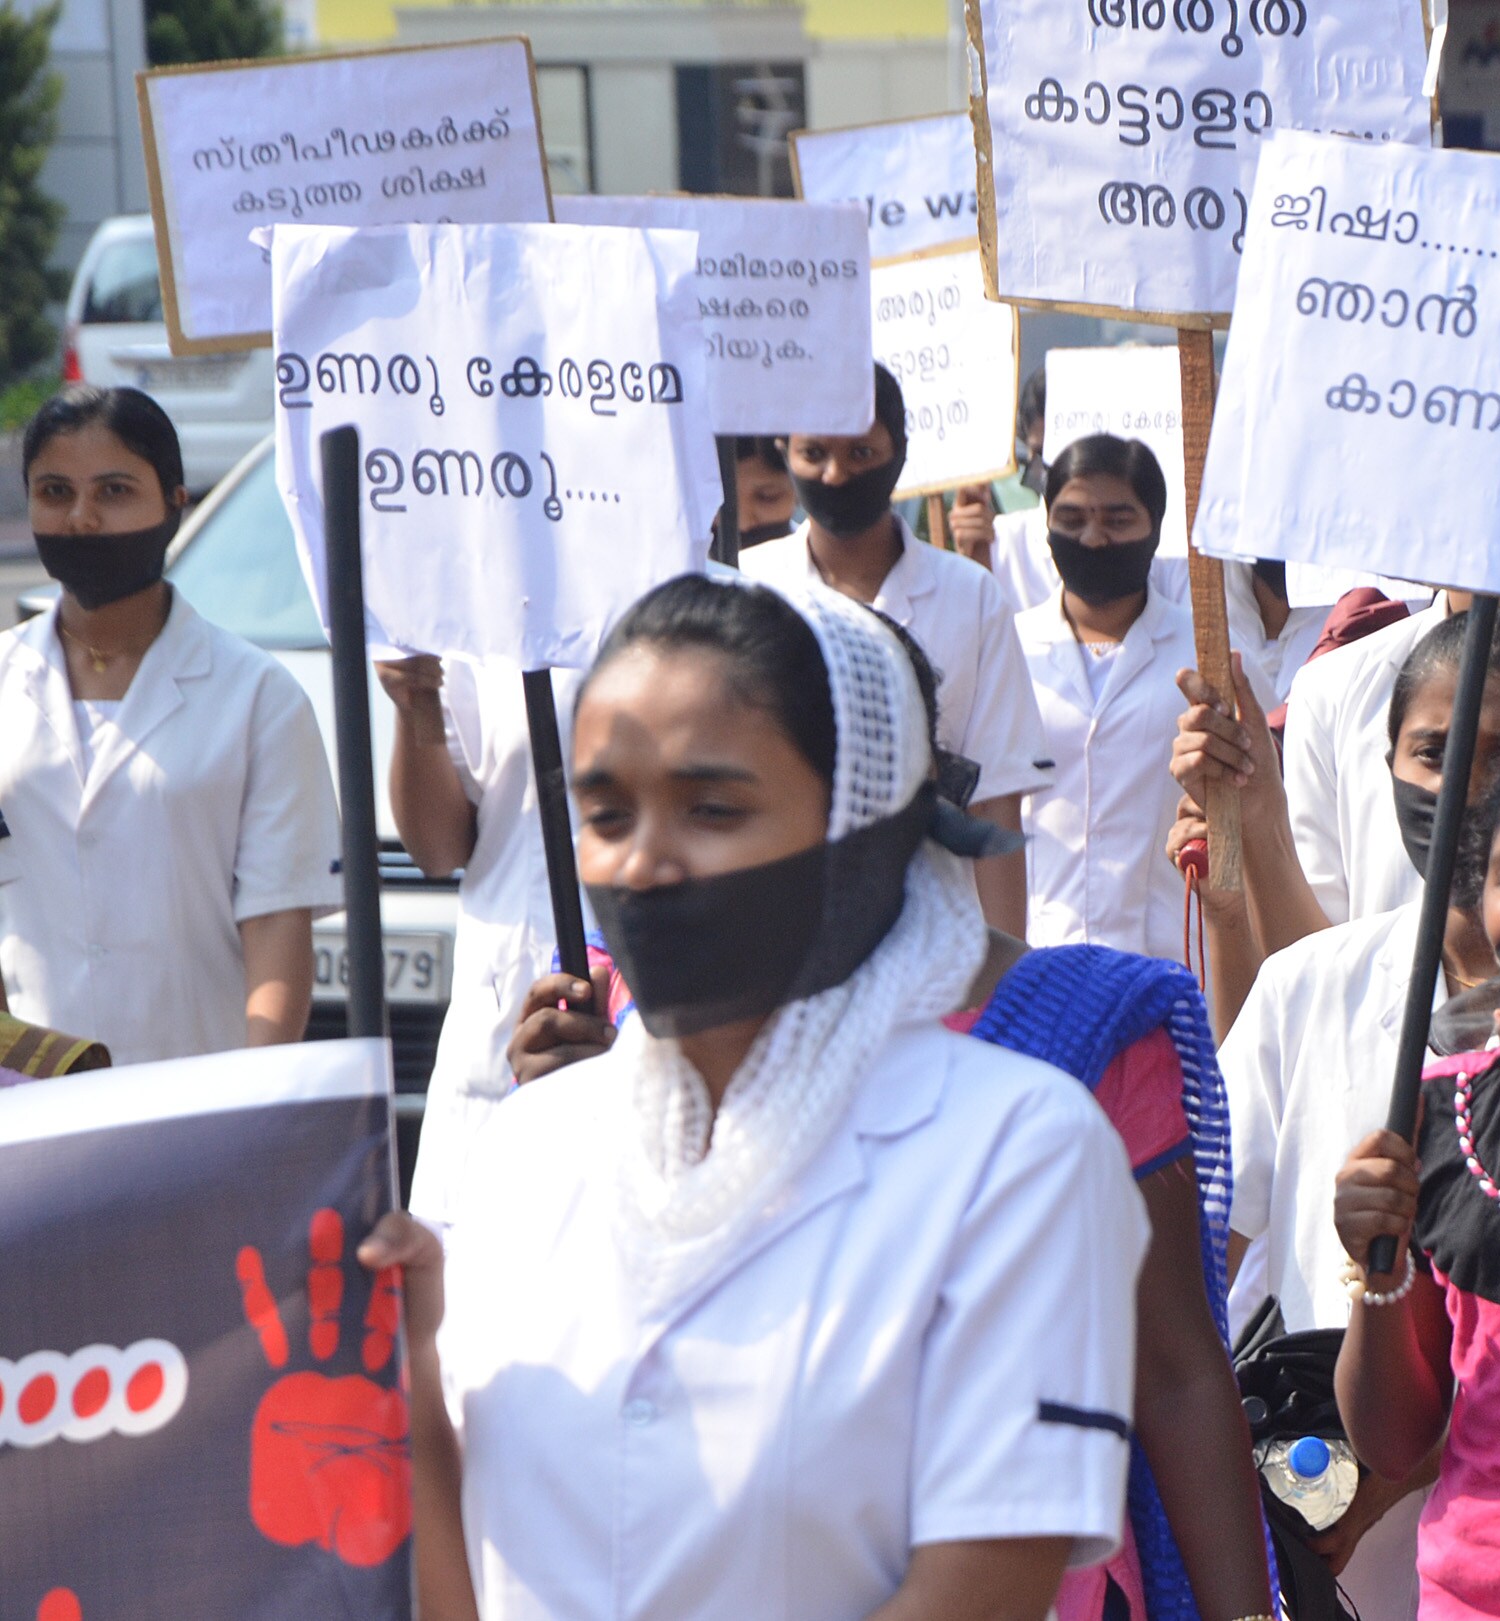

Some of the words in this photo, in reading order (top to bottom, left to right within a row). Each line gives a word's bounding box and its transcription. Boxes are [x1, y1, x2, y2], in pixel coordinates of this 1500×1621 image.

[1088, 0, 1307, 57] അരുത
[232, 179, 362, 219] കടുത്ത
[381, 167, 486, 200] ശിക്ഷ
[1099, 180, 1247, 254] അരു
[697, 253, 859, 288] ാമിമാരുടെ
[1296, 276, 1478, 339] ഞാൻ
[276, 352, 446, 417] ഉണരൂ
[466, 355, 684, 417] കേരളമേ
